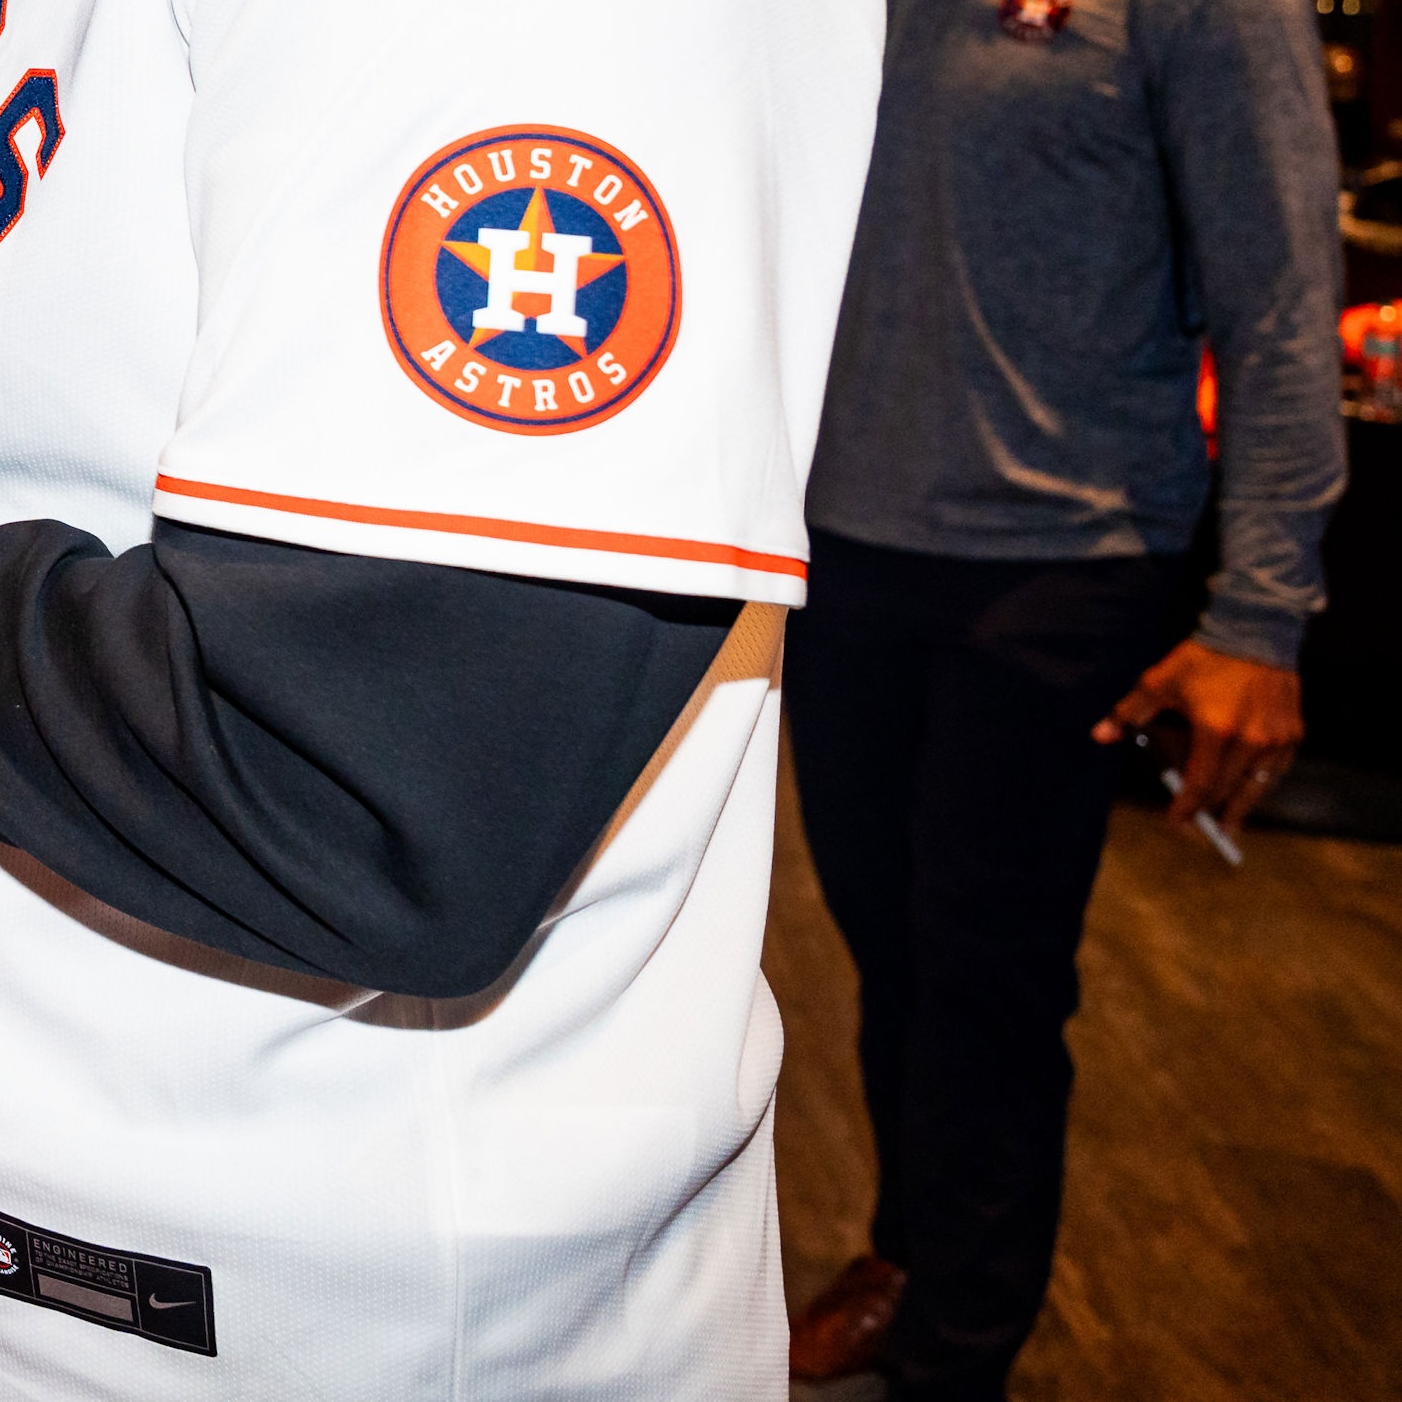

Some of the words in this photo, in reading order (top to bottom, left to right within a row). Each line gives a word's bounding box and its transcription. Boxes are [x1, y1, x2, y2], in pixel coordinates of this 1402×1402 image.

[420, 147, 649, 231] HOUSTON
[471, 227, 593, 338] H
[420, 339, 628, 412] ASTROS
[33, 1238, 128, 1274] ENGINEERED
